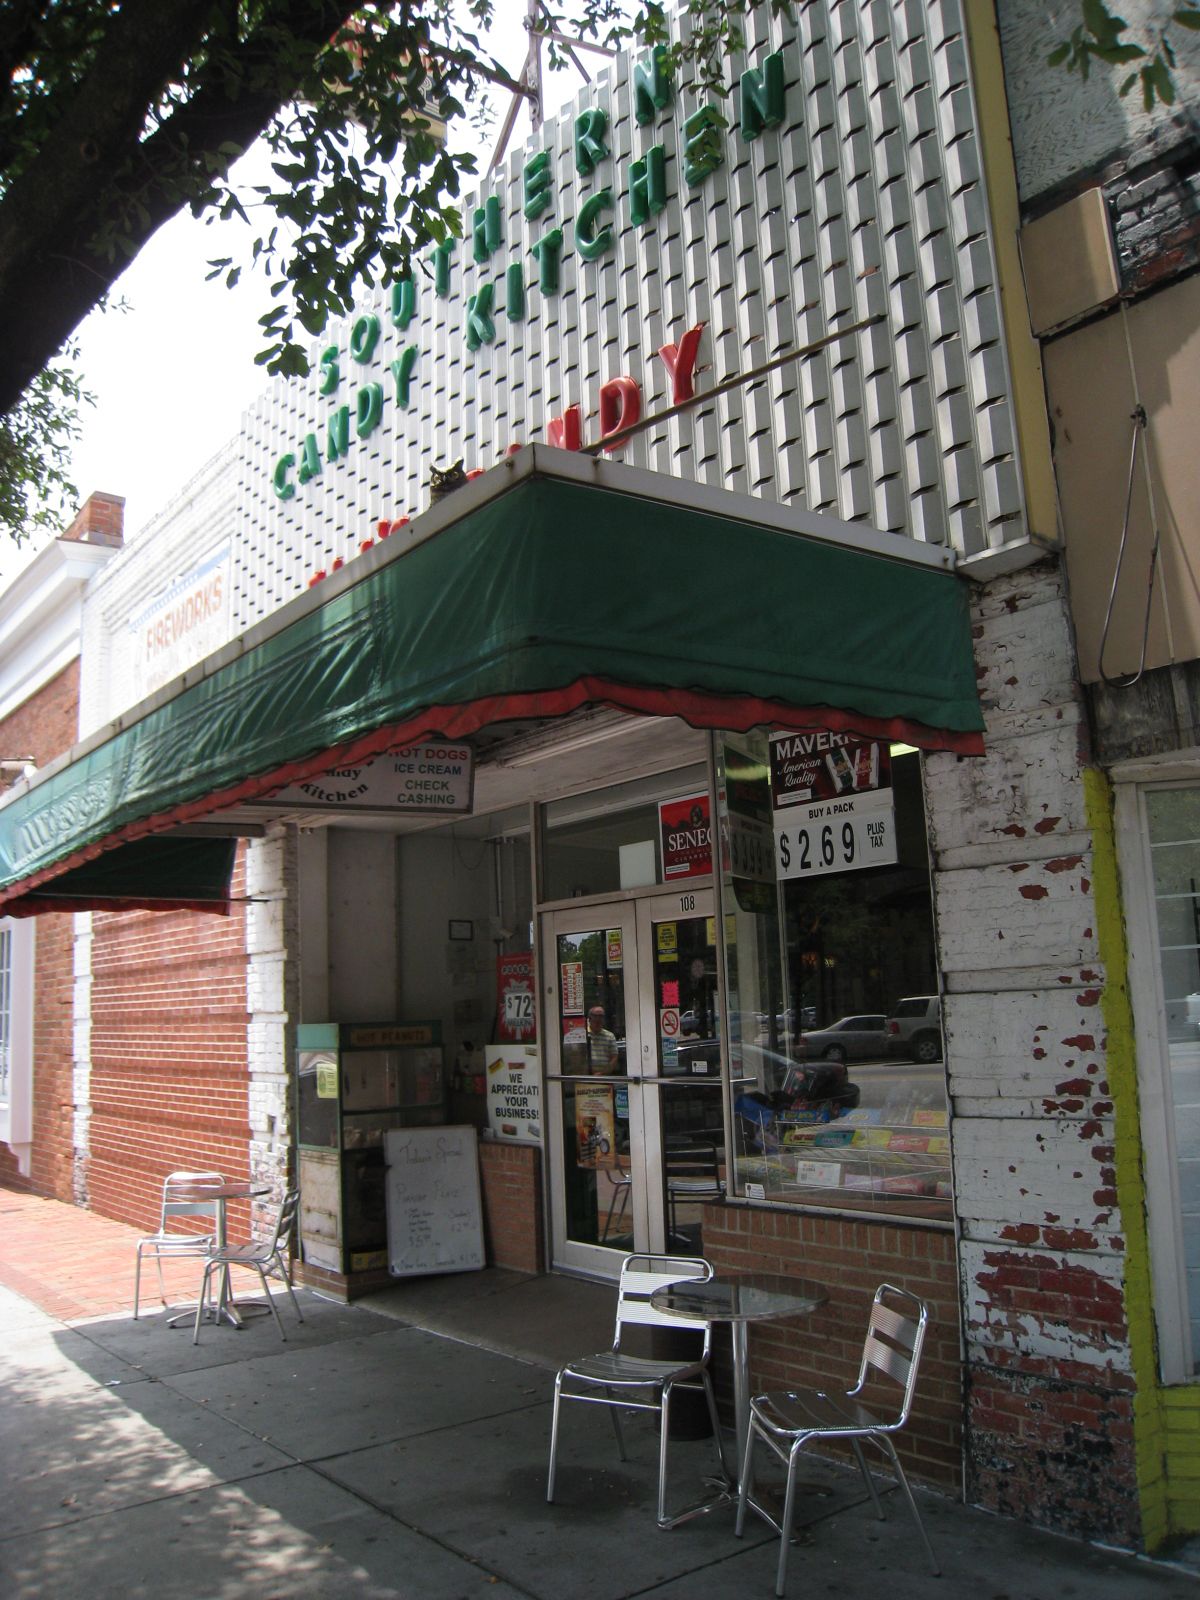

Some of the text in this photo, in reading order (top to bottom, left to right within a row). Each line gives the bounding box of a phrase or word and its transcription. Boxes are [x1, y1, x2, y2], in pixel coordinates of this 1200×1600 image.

[319, 45, 670, 396] SOUTHERN
[272, 50, 788, 501] CANDY KITCHEN
[146, 574, 223, 661] FIREWORKS
[424, 748, 468, 761] DOGS
[394, 763, 463, 775] ICE CREAM
[777, 758, 823, 775] American
[404, 779, 450, 791] CHECK
[784, 770, 817, 787] Quality
[396, 793, 456, 805] CASHING
[808, 801, 855, 820] BUY A PACK
[866, 821, 885, 836] PLUS
[779, 821, 856, 872] $2.69
[870, 836, 884, 849] TAX
[679, 894, 696, 913] 108
[507, 995, 532, 1018] $72
[509, 1073, 523, 1084] WE
[505, 1096, 529, 1108] YOUR
